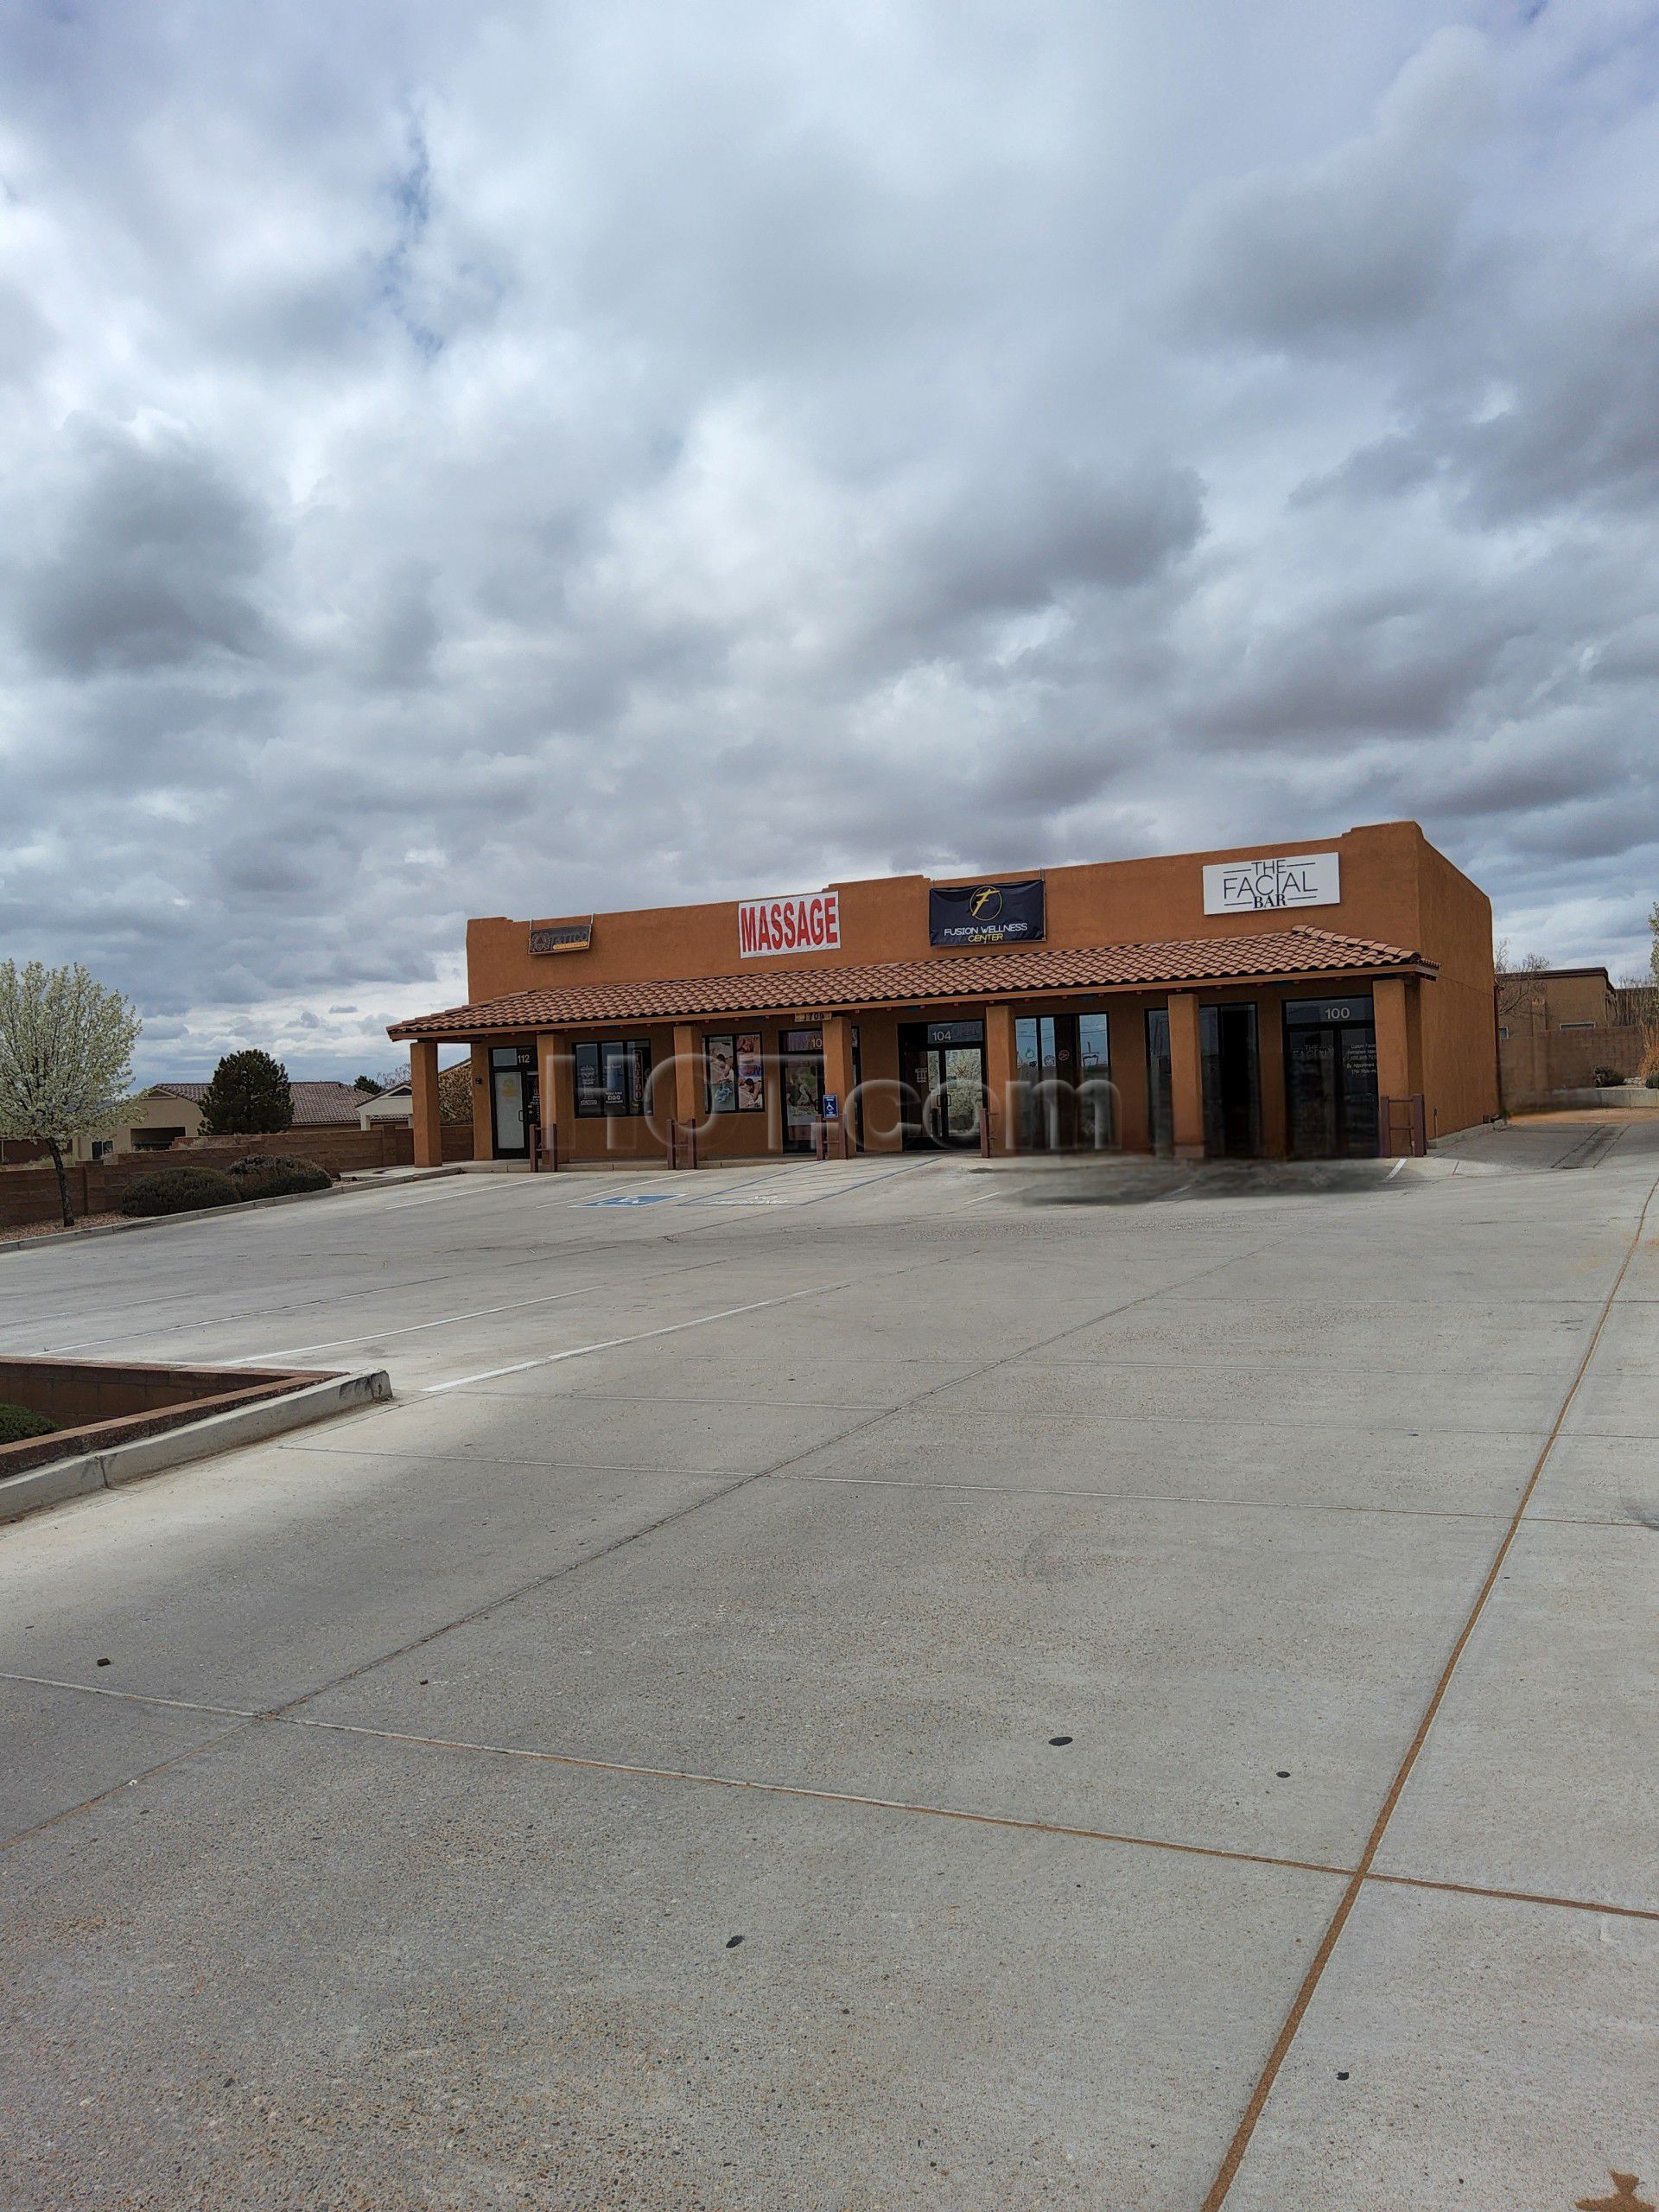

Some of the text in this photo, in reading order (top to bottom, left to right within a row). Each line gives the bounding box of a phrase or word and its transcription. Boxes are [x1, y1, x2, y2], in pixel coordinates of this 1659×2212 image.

[1251, 860, 1287, 875] THE
[1224, 871, 1319, 899] FACIAL
[1253, 894, 1287, 908] BAR
[741, 897, 837, 952] MASSAGE
[944, 923, 1028, 936] FUSION WELLNESS
[968, 933, 1004, 943] CENTER
[1325, 1007, 1350, 1020] 100
[932, 1031, 951, 1041] 104
[811, 1038, 823, 1048] 10
[517, 1054, 531, 1064] 112
